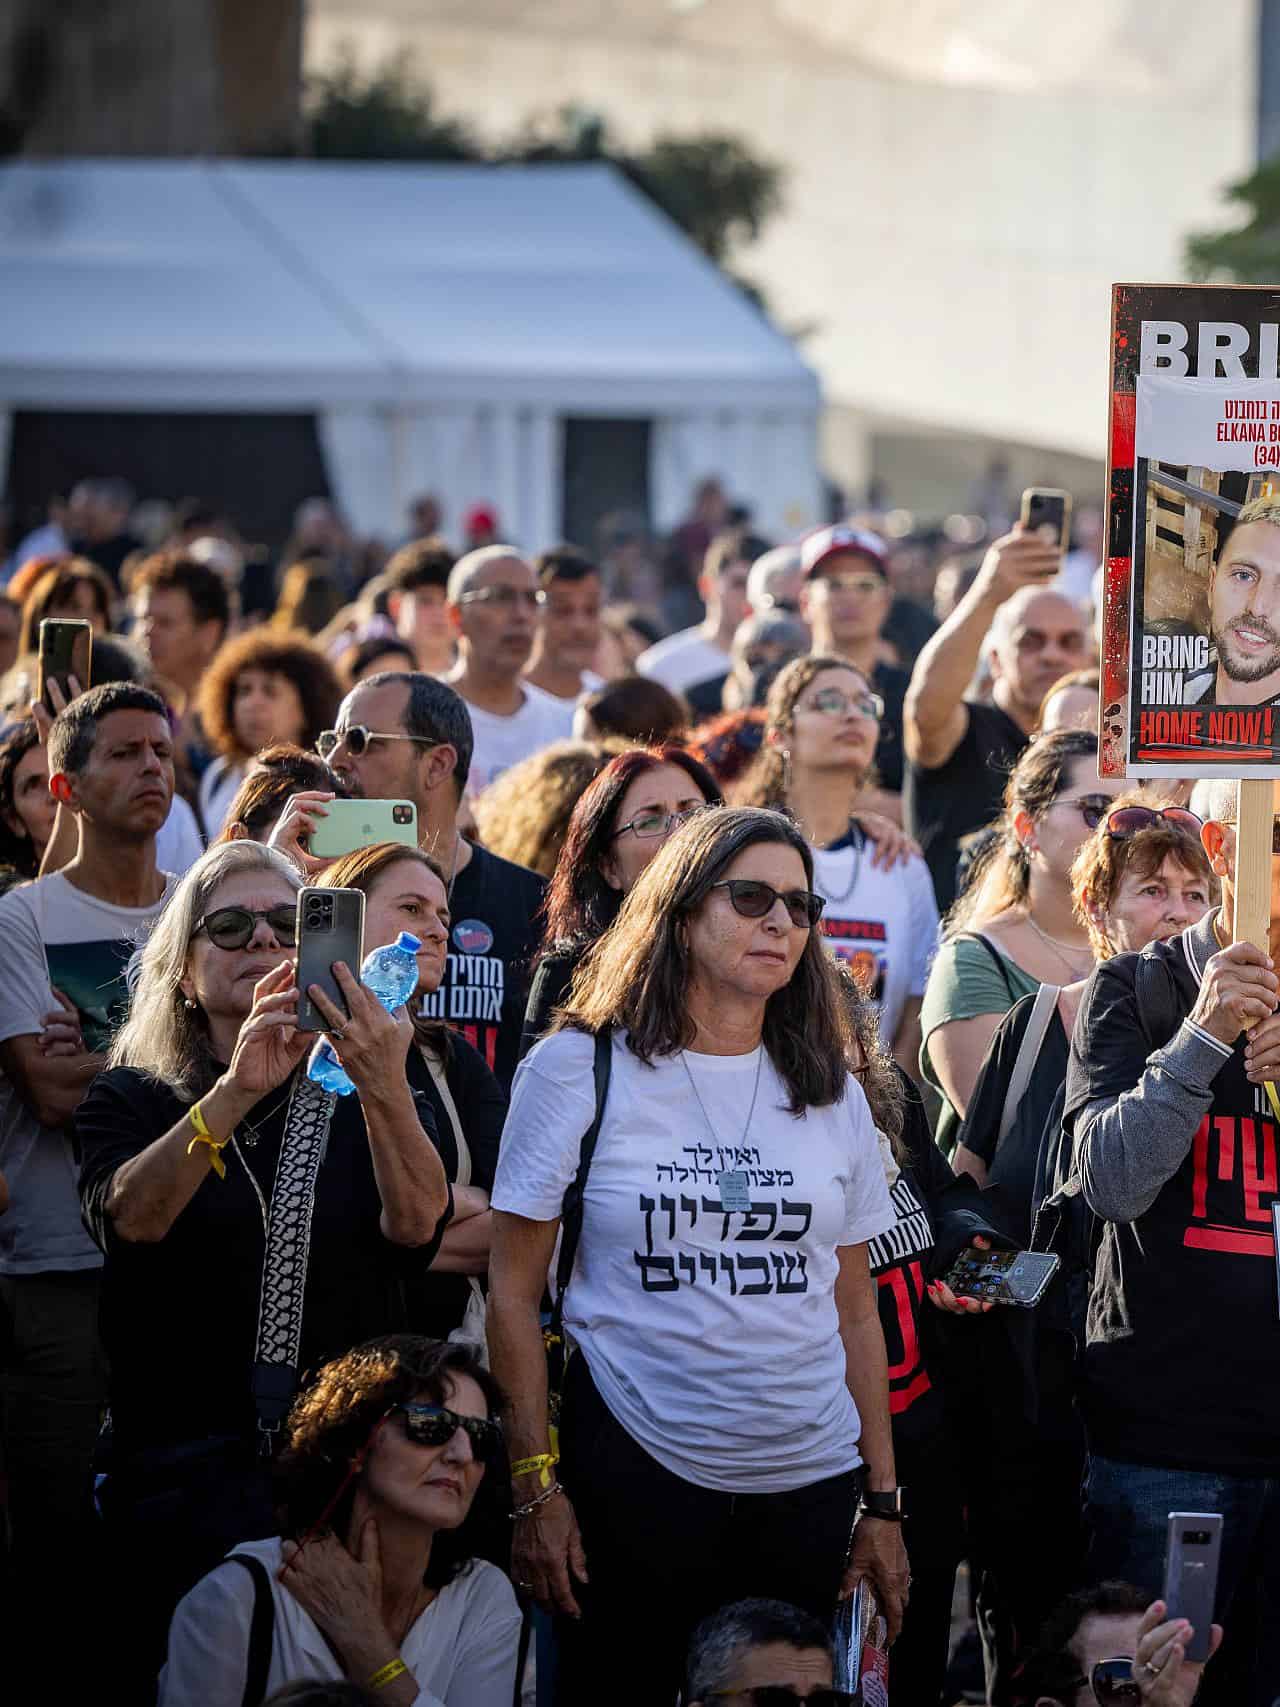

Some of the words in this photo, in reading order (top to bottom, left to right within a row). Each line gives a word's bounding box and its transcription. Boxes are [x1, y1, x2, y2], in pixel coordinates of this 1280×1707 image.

[1225, 399, 1267, 420] בוחבוט
[1217, 422, 1266, 442] ELKANA
[1254, 444, 1280, 467] (34)
[1143, 635, 1209, 669] BRING
[1141, 671, 1183, 705] HIM
[1140, 711, 1203, 745] HOME
[1208, 707, 1272, 745] NOW!
[445, 954, 504, 987] מחזיר
[451, 985, 504, 1022] אותם
[683, 1142, 713, 1171] לך
[717, 1146, 760, 1172] ואין
[640, 1193, 812, 1257] כפדיון
[634, 1250, 808, 1296] שבויים
